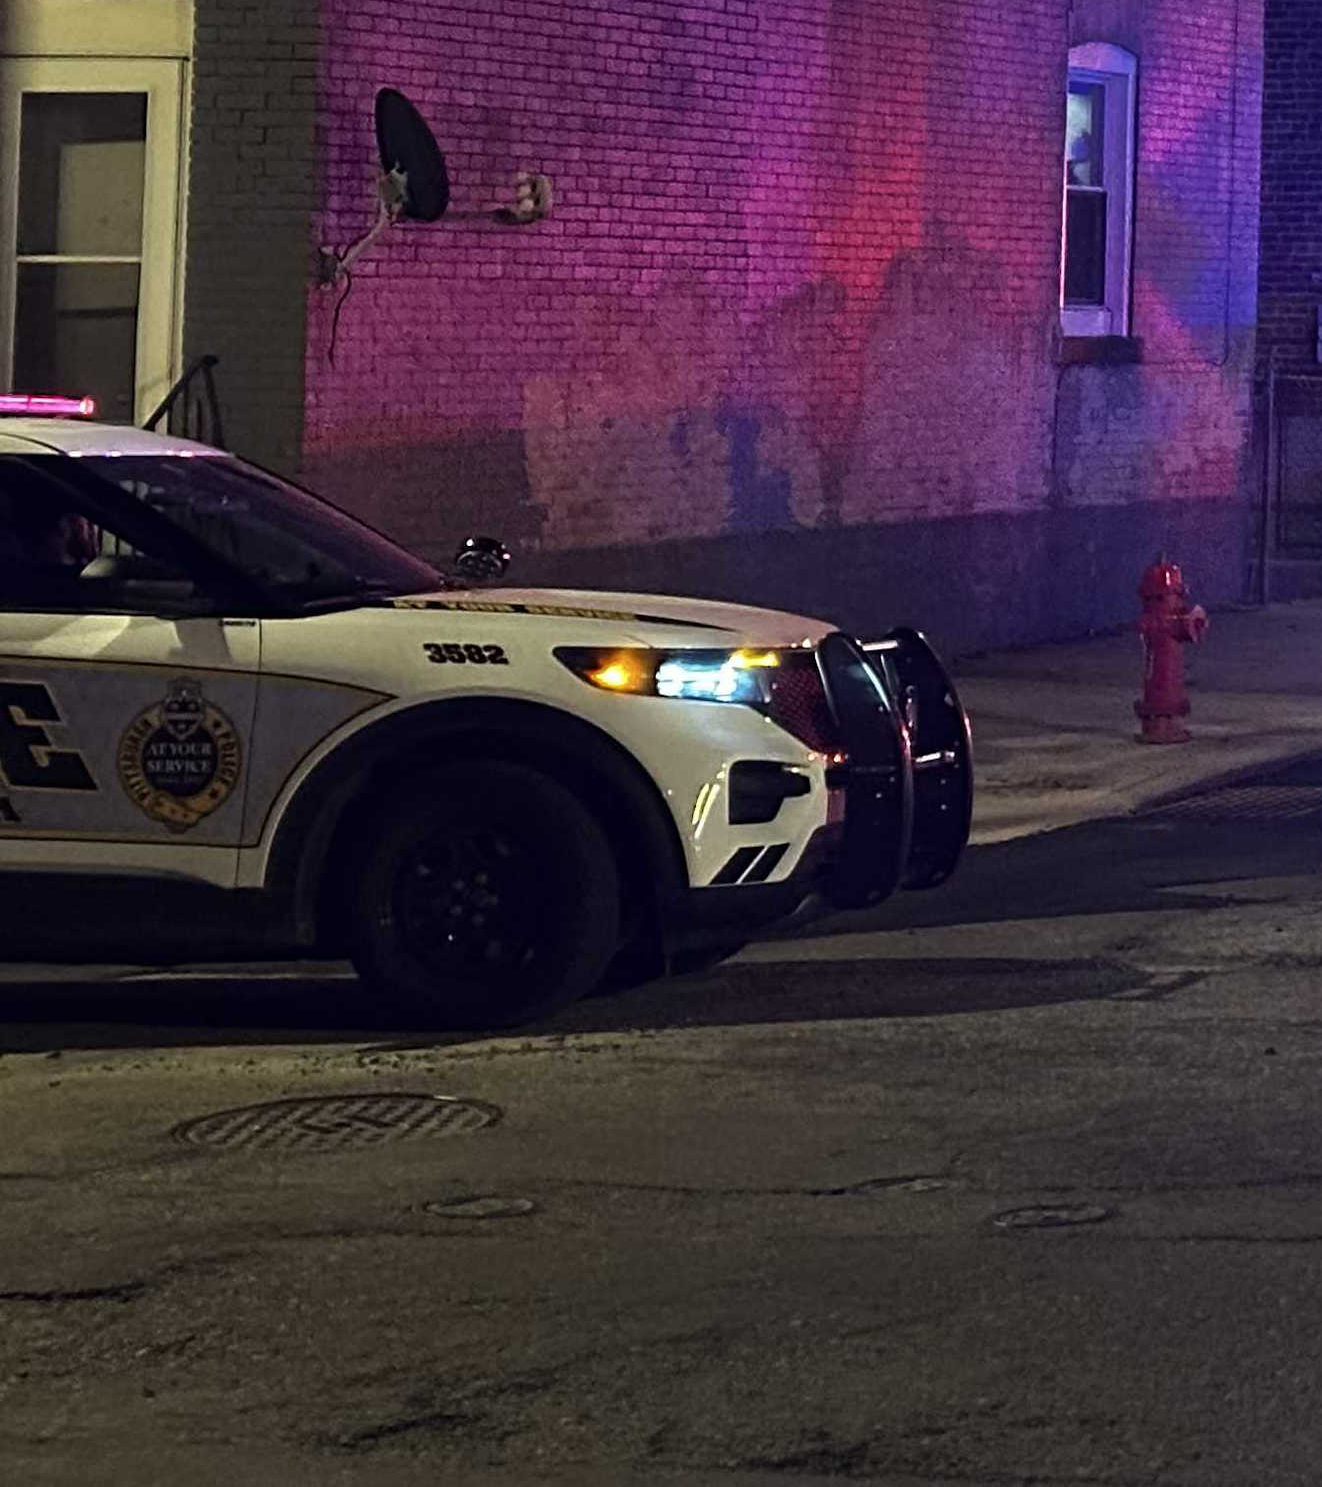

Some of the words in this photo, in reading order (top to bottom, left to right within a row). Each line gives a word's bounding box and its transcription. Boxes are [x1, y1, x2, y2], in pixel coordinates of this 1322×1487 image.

[422, 642, 510, 666] 3582
[147, 742, 168, 756] AT
[168, 742, 212, 756] YOUR
[146, 759, 212, 774] SERVICE
